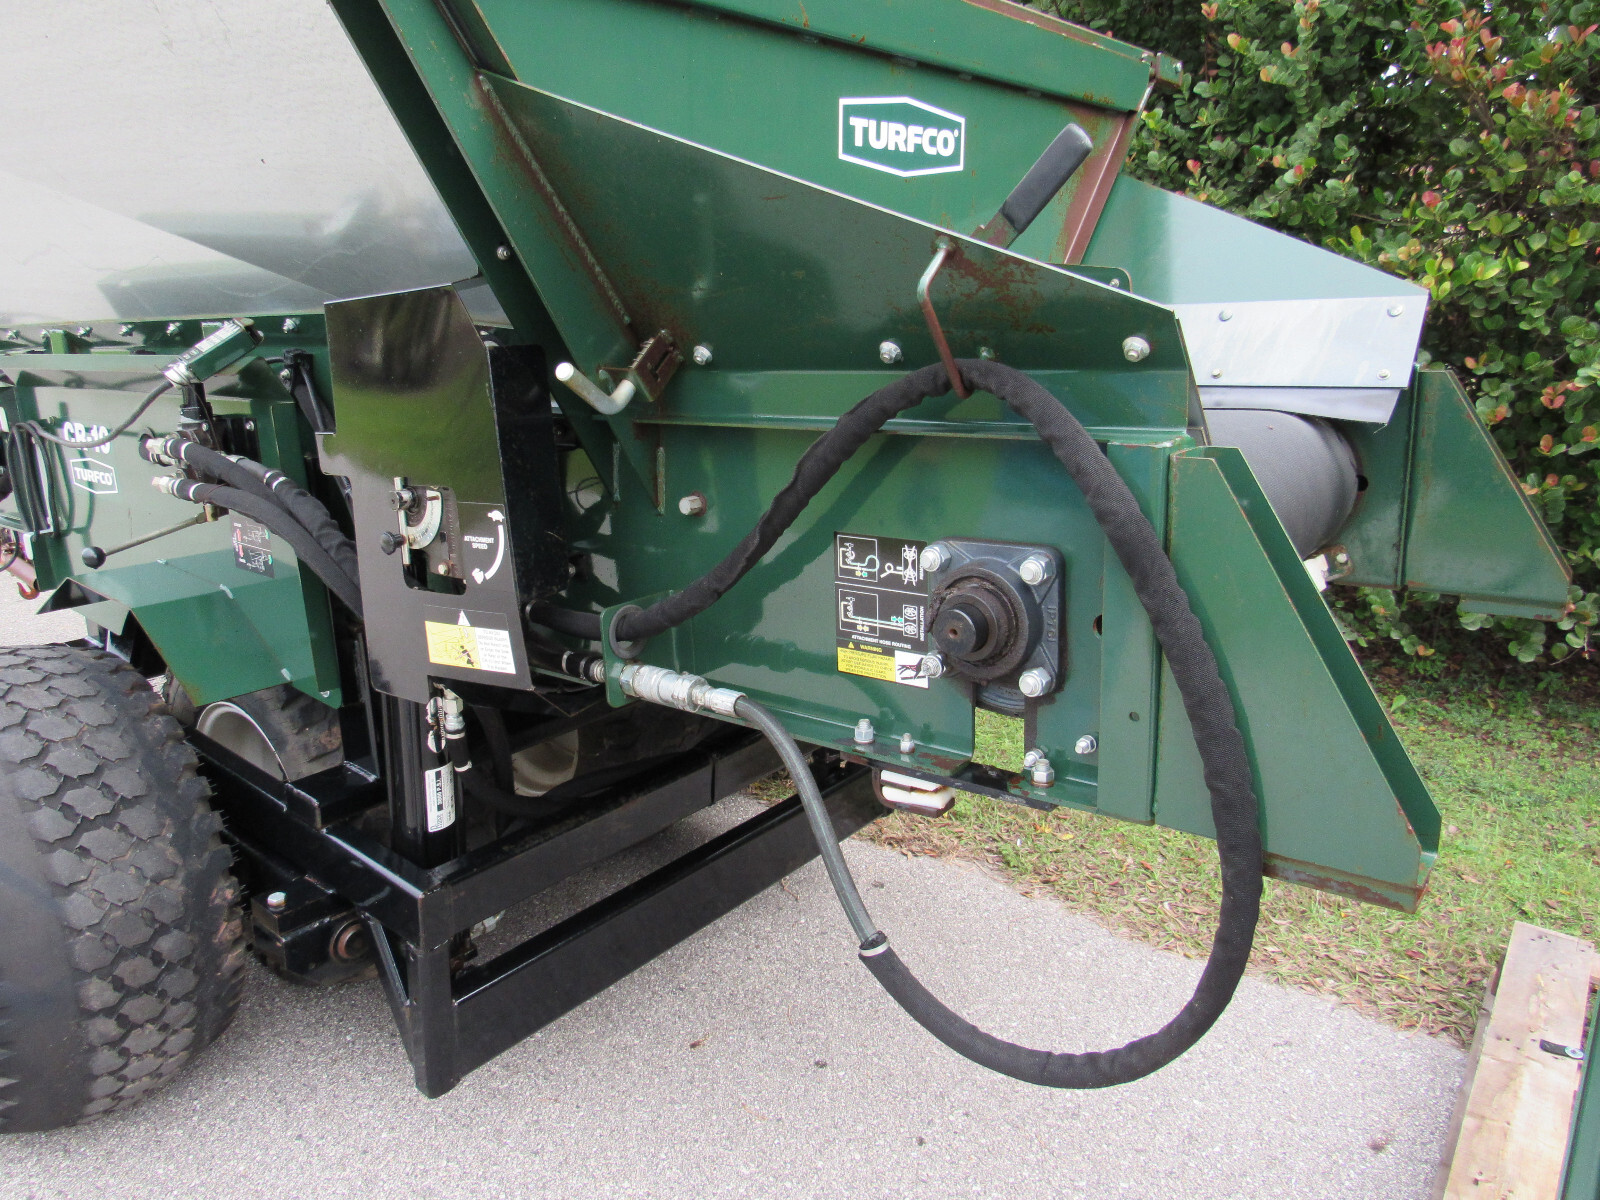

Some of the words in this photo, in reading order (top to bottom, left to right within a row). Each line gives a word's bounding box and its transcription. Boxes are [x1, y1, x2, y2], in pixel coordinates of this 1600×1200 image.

[849, 116, 956, 157] TURFCO
[74, 466, 113, 486] TURFCO
[464, 536, 494, 544] ATTACHMENT
[852, 635, 878, 643] ATTACHMENT
[860, 644, 882, 652] WARNING
